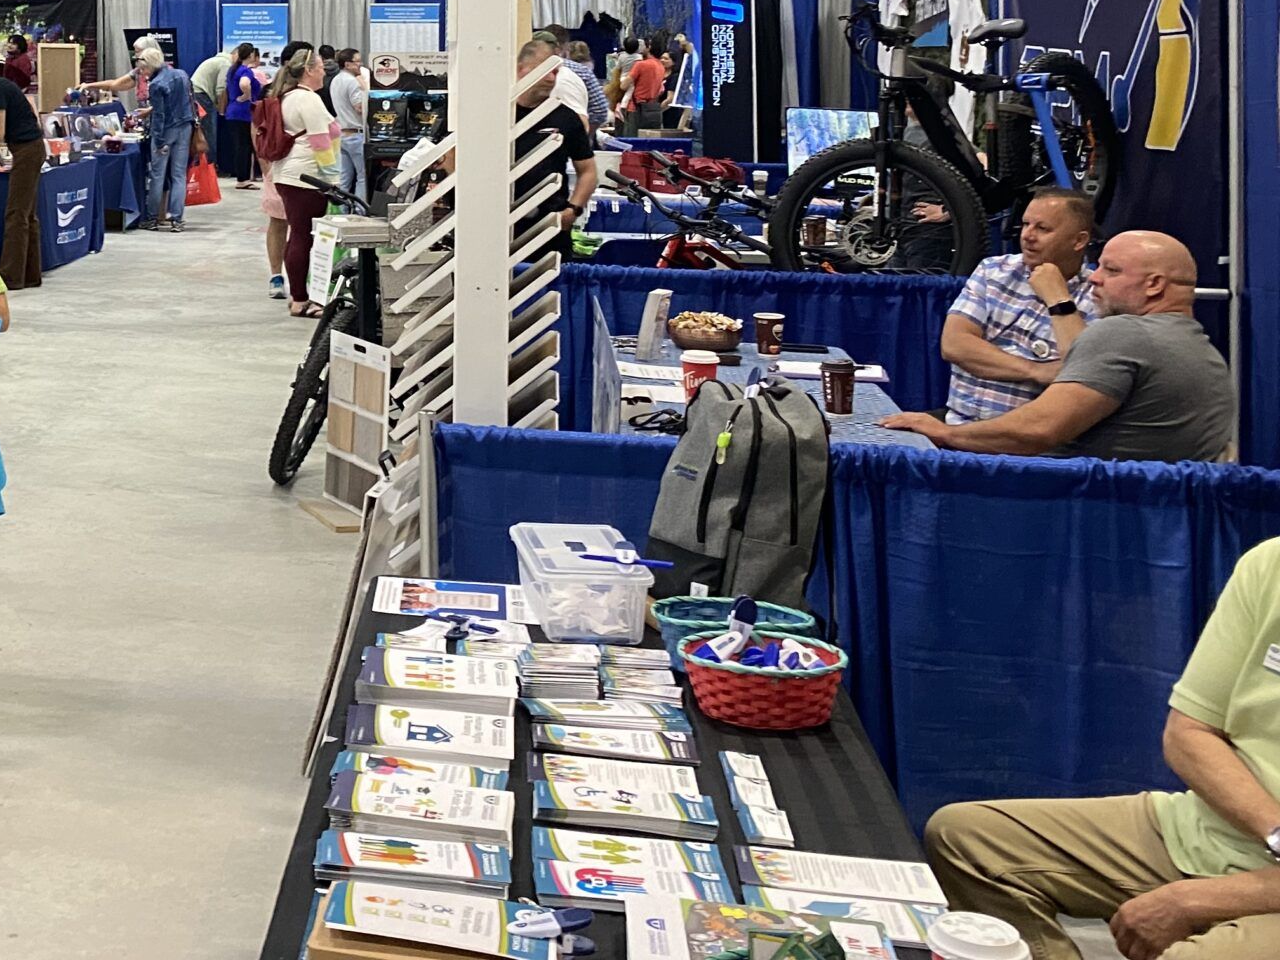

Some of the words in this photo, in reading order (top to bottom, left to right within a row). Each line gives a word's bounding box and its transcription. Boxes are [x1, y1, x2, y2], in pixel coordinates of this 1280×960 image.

[711, 25, 720, 106] CONSTRUCTION
[719, 24, 727, 85] INDUSTRIAL
[726, 24, 735, 84] NORTHERN
